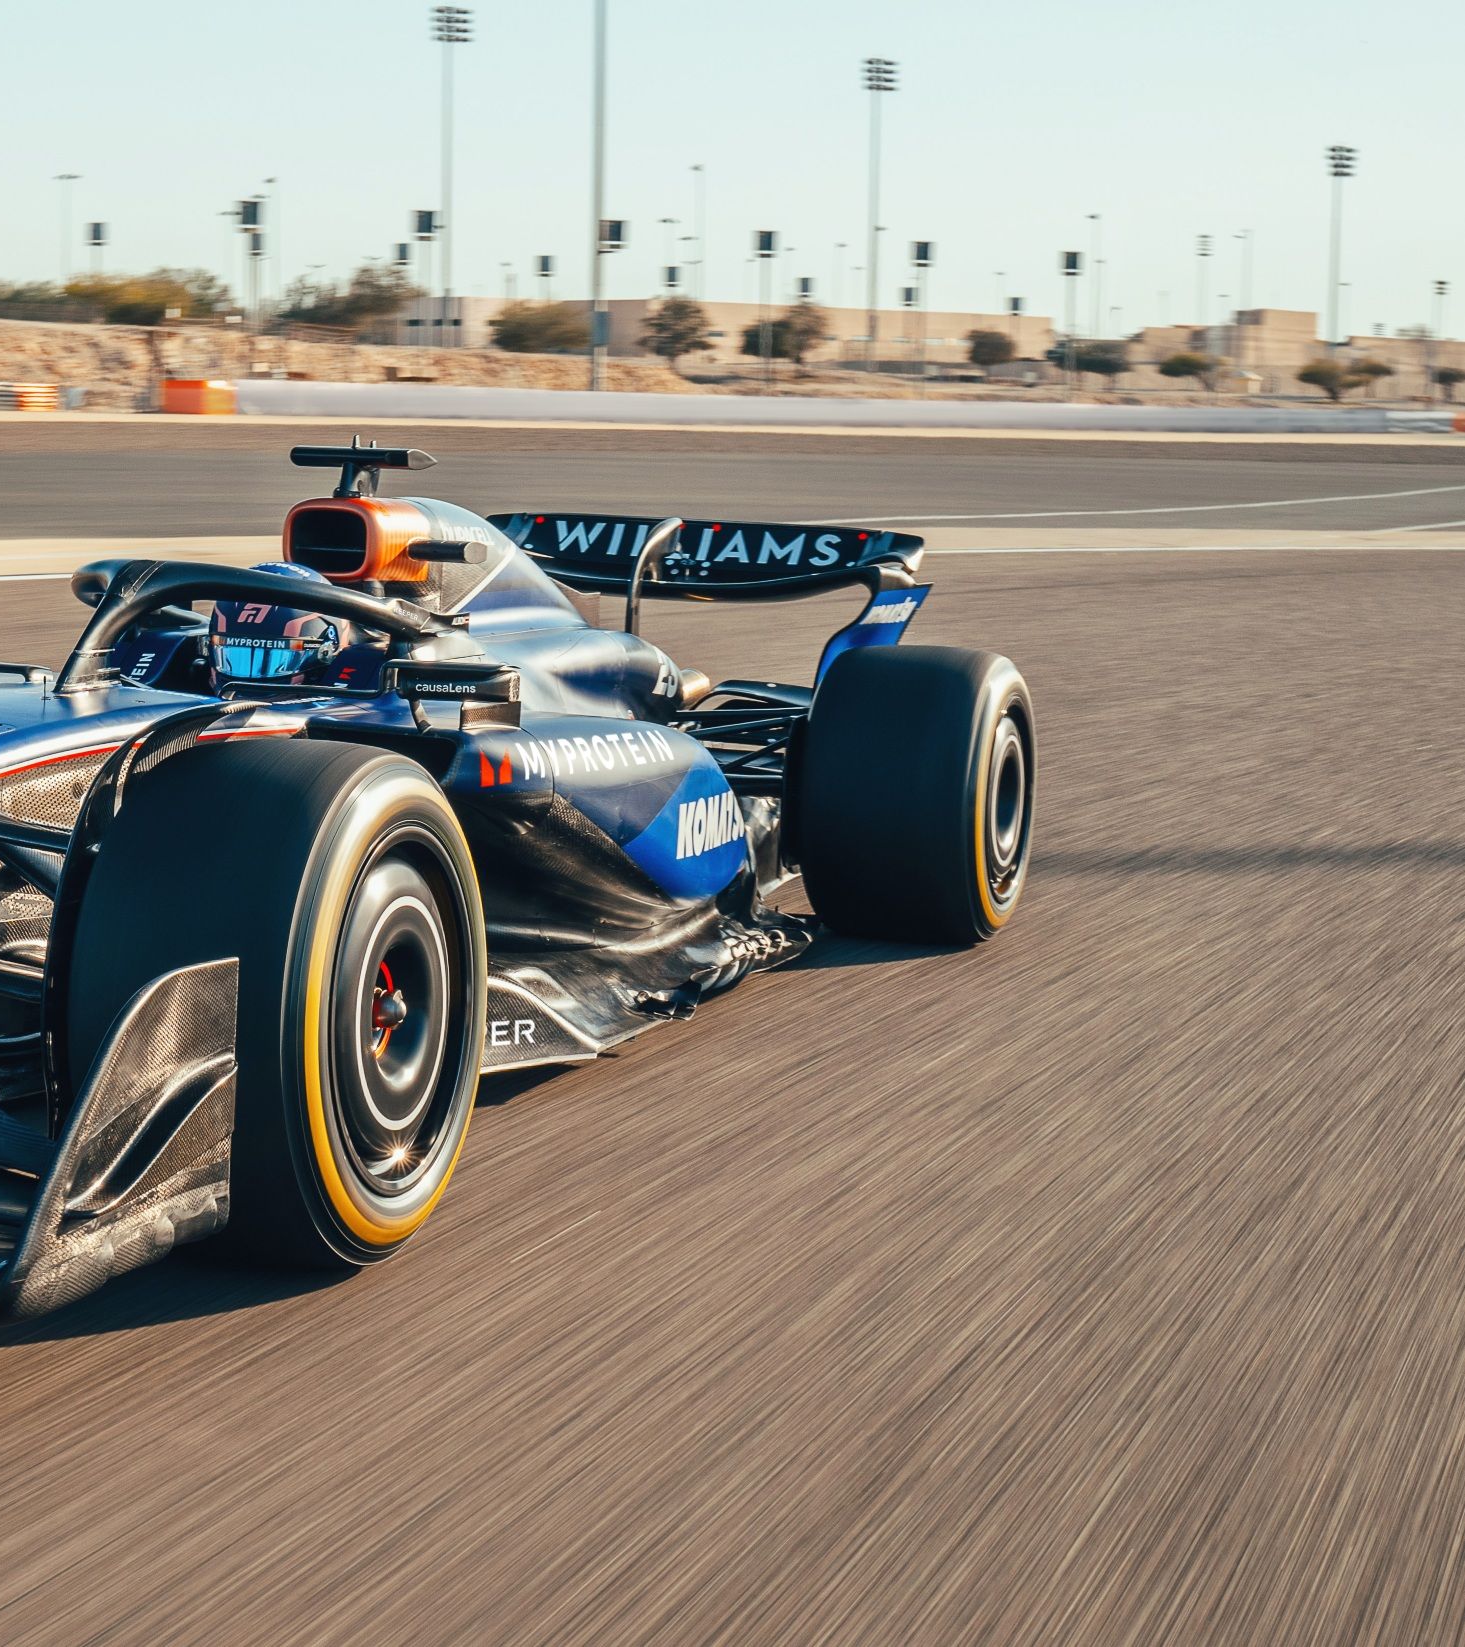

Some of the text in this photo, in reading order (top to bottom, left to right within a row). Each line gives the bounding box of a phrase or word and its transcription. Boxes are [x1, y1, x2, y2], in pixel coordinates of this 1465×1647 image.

[555, 519, 843, 567] WILIAMS
[226, 637, 286, 649] MYPROTEIN
[415, 683, 476, 693] causaLens
[514, 729, 675, 781] MYPROTEIN
[675, 790, 745, 860] KOMATS
[489, 1018, 536, 1047] ER
